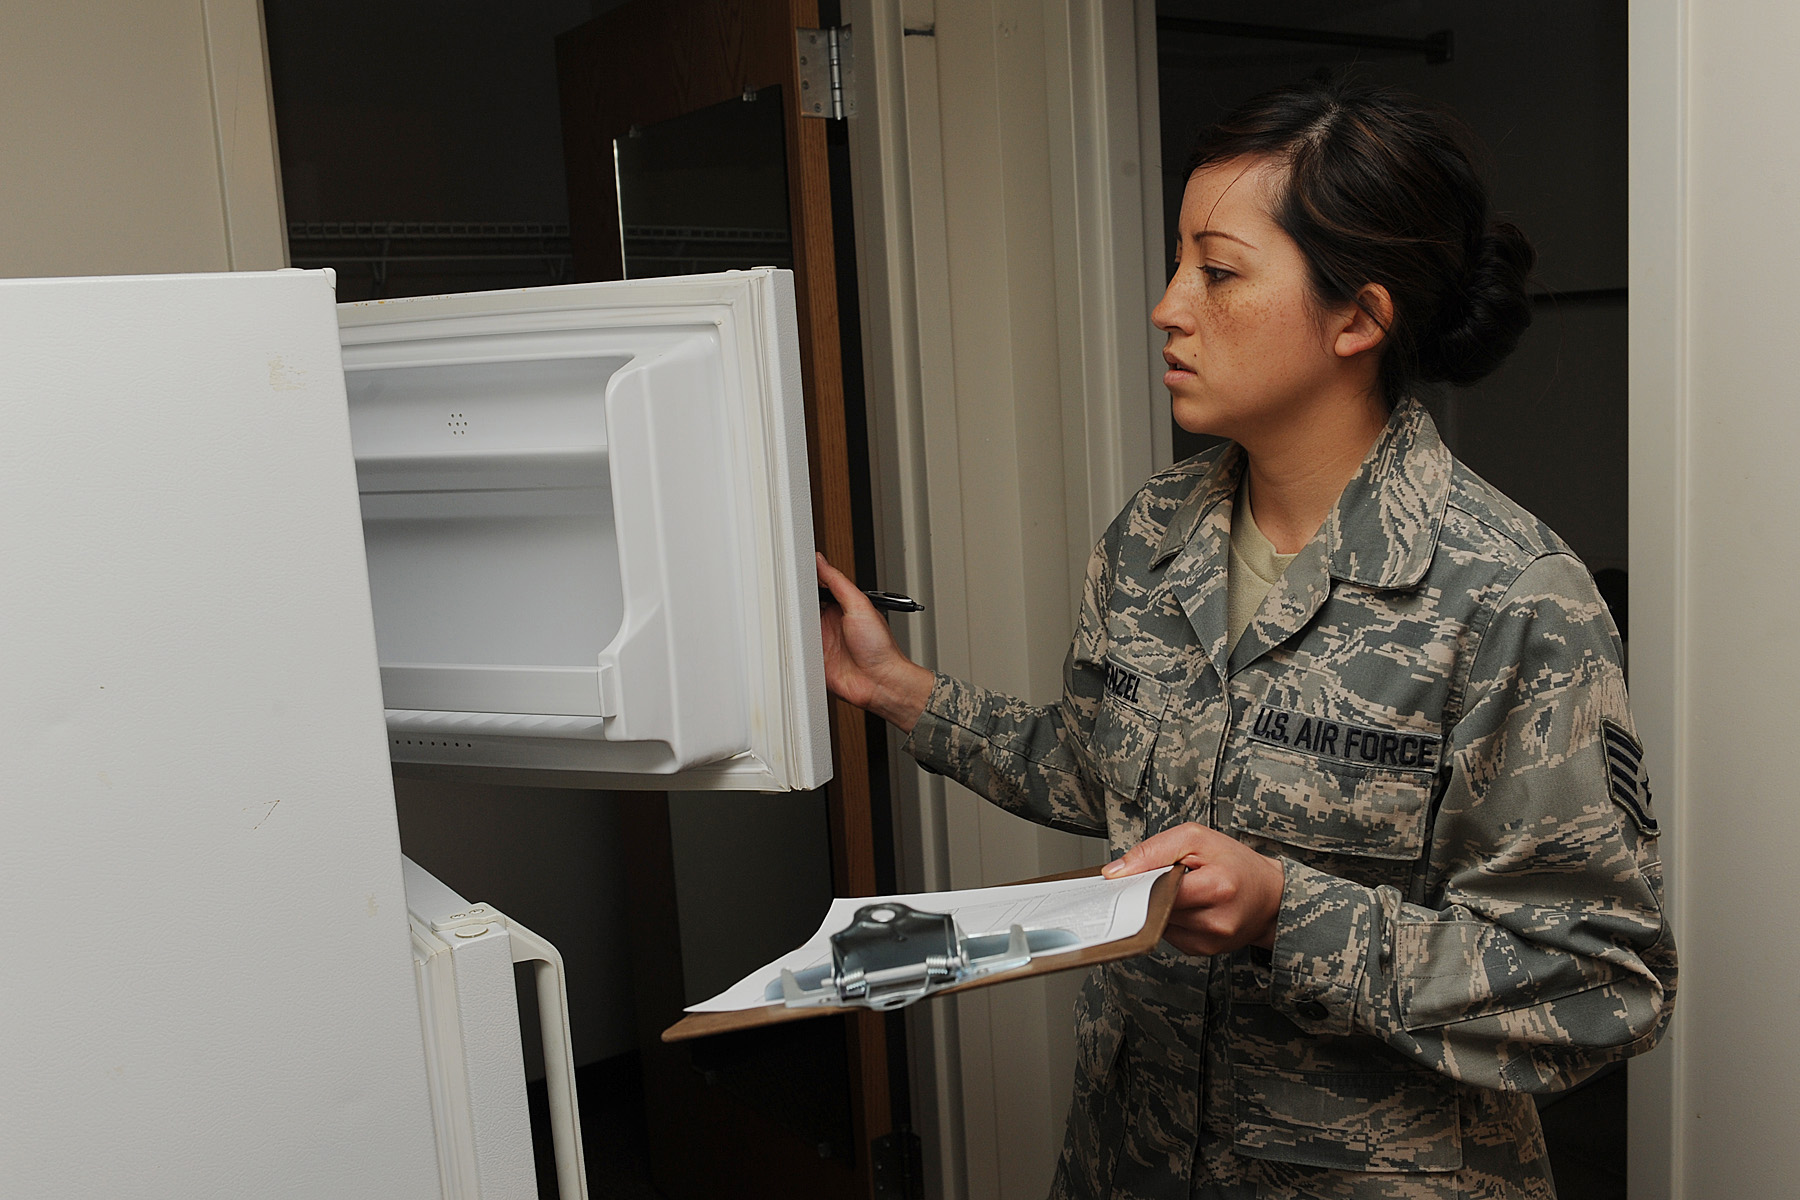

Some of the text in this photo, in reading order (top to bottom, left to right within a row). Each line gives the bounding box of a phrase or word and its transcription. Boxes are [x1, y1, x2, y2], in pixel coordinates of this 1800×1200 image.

[1253, 707, 1437, 766] U.S. AIR FORCE
